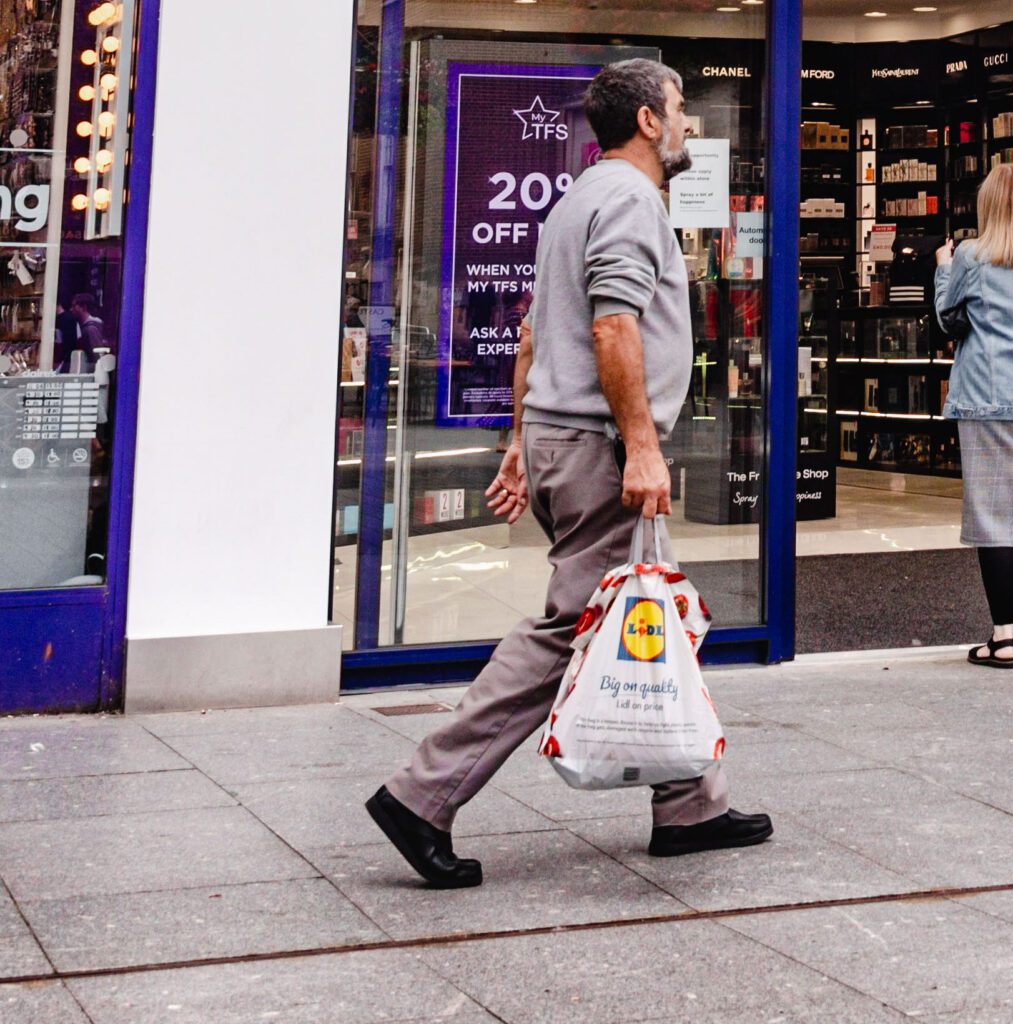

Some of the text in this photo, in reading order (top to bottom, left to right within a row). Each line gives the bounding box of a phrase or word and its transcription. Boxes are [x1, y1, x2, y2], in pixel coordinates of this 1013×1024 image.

[984, 53, 1008, 67] GUCCI
[702, 66, 751, 77] CHANEL
[946, 60, 968, 74] PRADA
[801, 69, 835, 79] M FORD
[531, 113, 546, 123] My
[531, 123, 569, 140] TFS
[472, 222, 529, 244] OFF
[739, 226, 764, 234] Autom
[466, 264, 510, 276] WHEN
[468, 281, 536, 293] MY TFS M
[469, 327, 499, 339] ASK
[502, 327, 513, 339] A
[726, 471, 760, 482] The Fr
[803, 469, 829, 480] Shop
[733, 491, 759, 508] Spray
[600, 675, 621, 698] Big
[623, 681, 637, 692] on
[616, 699, 631, 709] Lidl
[643, 703, 664, 712] price
